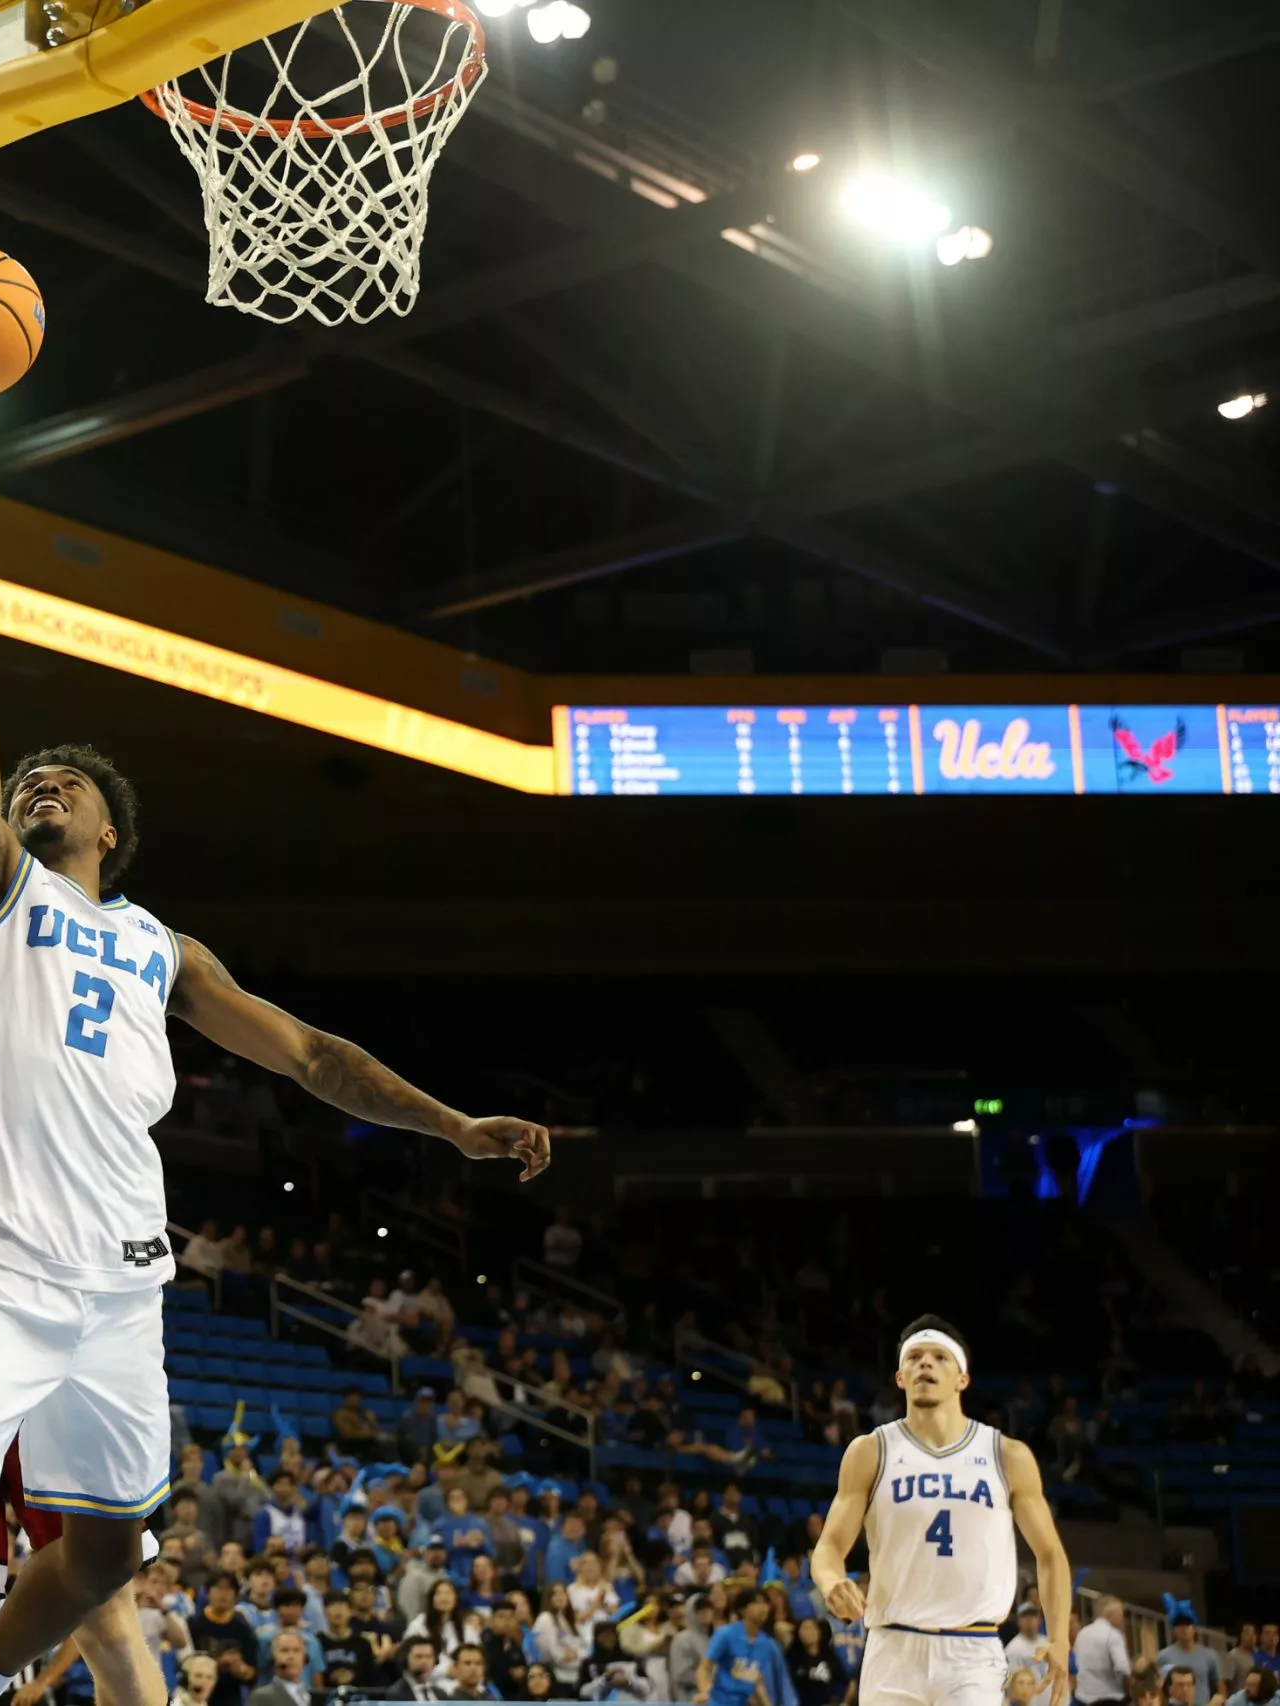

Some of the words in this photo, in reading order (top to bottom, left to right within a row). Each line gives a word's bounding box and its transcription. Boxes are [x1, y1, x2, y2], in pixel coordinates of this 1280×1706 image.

[10, 600, 67, 636] BACK
[70, 620, 104, 648] ON
[107, 630, 159, 664] UCLA
[164, 644, 265, 698] ATHLETICS
[932, 716, 1056, 782] Ucla
[25, 904, 168, 1007] UCLA
[64, 970, 116, 1059] 2
[891, 1473, 994, 1509] UCLA
[925, 1509, 953, 1557] 4
